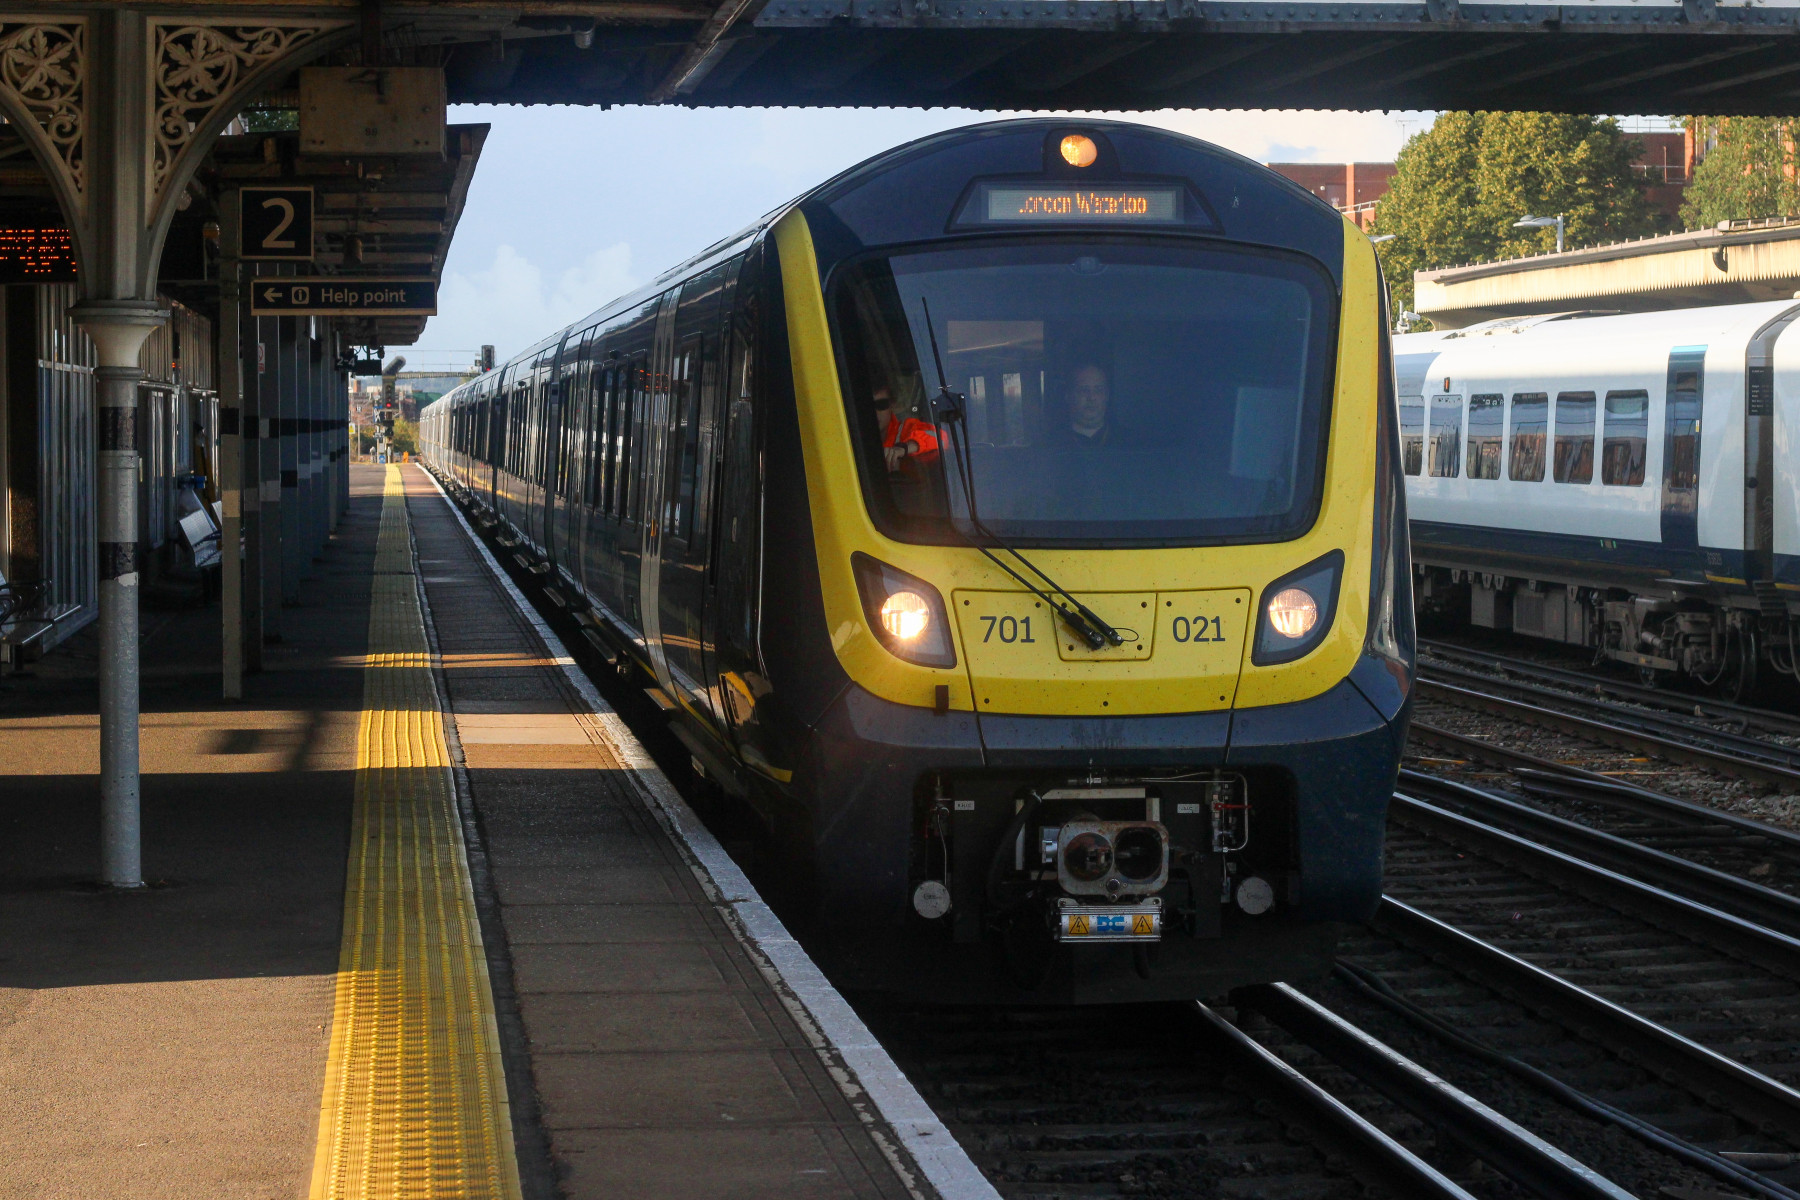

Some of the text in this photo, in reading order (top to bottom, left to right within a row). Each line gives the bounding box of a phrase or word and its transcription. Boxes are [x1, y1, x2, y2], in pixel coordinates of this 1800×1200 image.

[261, 197, 296, 249] 2
[321, 288, 407, 306] Help point
[336, 356, 356, 367] 2-4
[979, 615, 1036, 644] 701
[1172, 615, 1226, 643] 021
